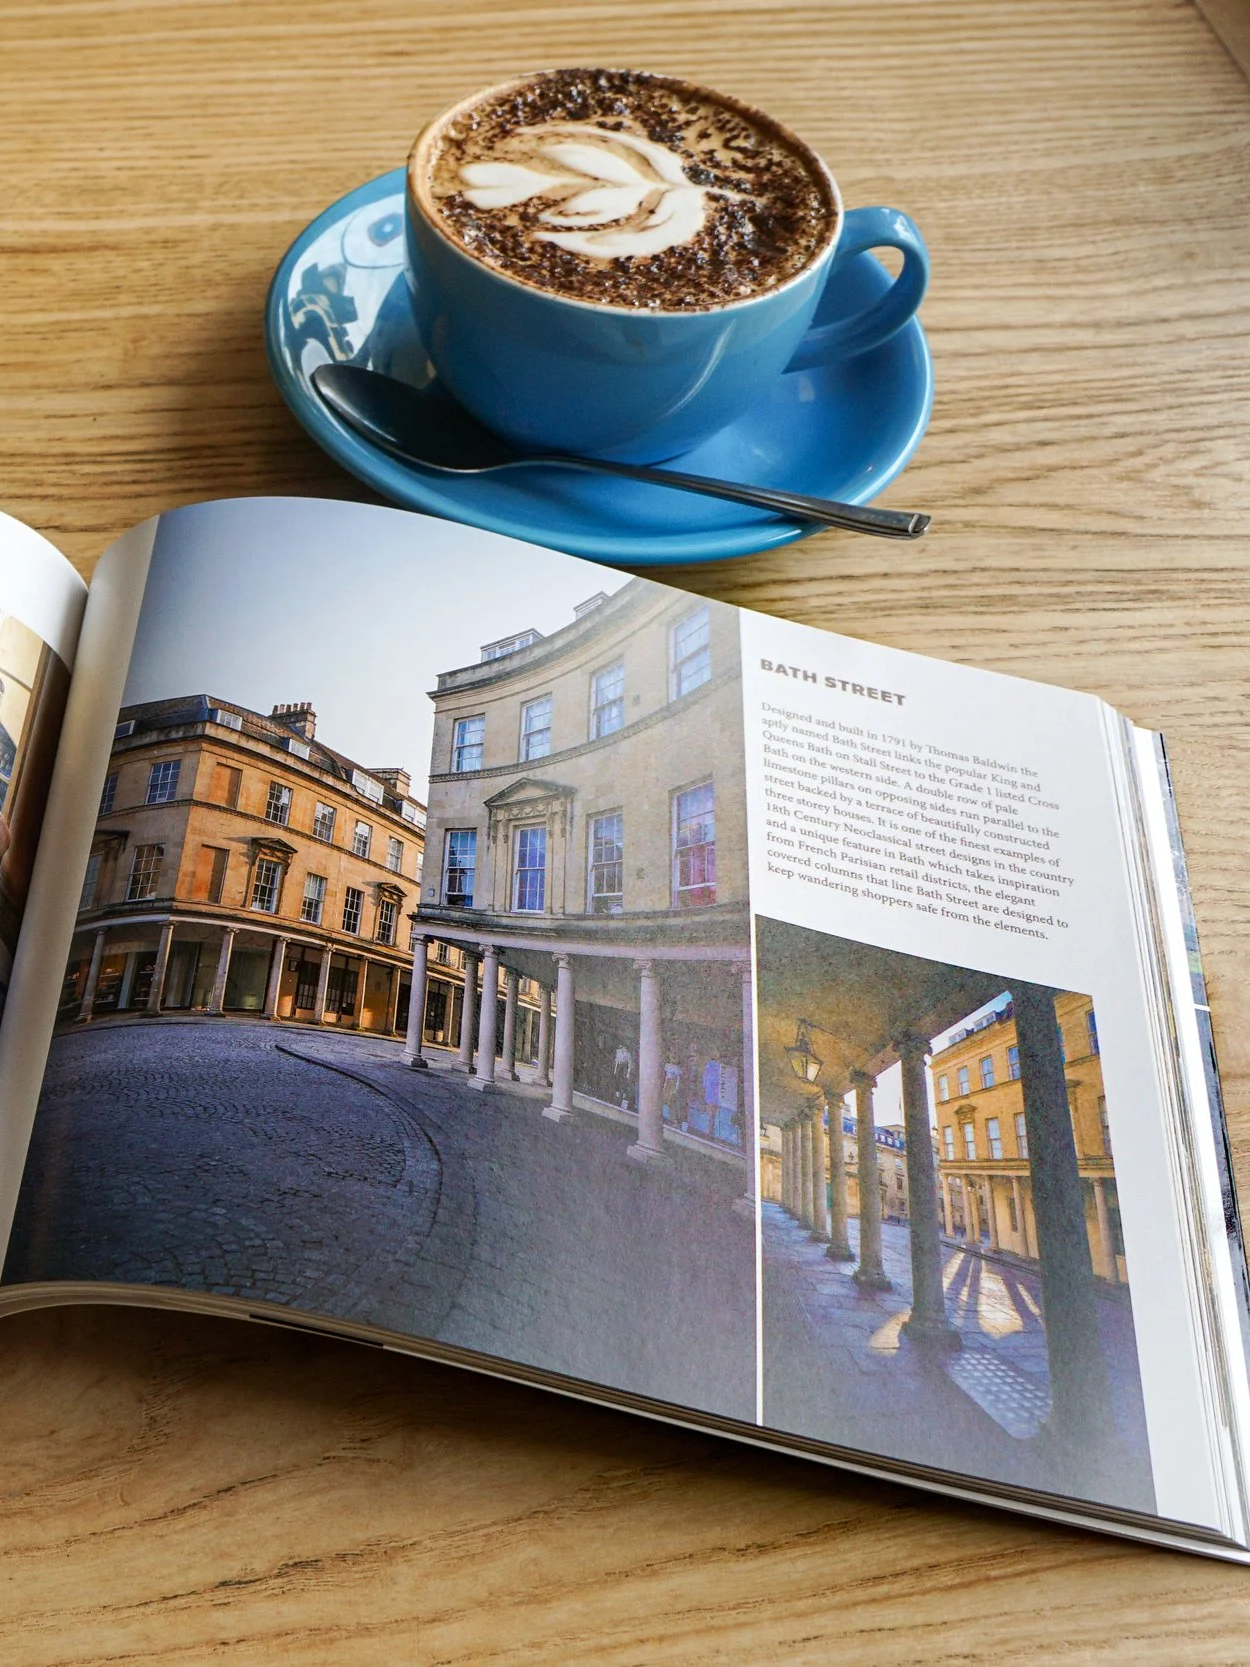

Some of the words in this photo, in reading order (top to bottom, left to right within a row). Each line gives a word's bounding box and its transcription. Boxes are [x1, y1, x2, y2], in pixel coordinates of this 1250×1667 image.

[760, 658, 817, 684] BATH
[825, 676, 906, 706] STREET
[766, 819, 787, 830] and
[800, 828, 839, 844] unique
[842, 837, 881, 854] feature
[884, 848, 895, 858] in
[899, 852, 924, 865] Bath
[928, 861, 962, 874] which
[966, 869, 994, 881] takes
[998, 875, 1059, 896] inspiration
[767, 803, 790, 816] 18th
[794, 810, 840, 831] Century
[843, 823, 911, 848] Neoclassical
[915, 843, 945, 856] street
[949, 850, 990, 866] designs
[994, 860, 1005, 869] in
[1008, 863, 1026, 874] the
[1030, 870, 1074, 886] country
[767, 832, 794, 847] from
[799, 841, 836, 858] French
[841, 852, 885, 871] Parisian
[890, 867, 918, 879] retail
[922, 873, 970, 892] districts,
[974, 885, 991, 896] the
[995, 891, 1035, 906] elegant
[767, 850, 811, 866] covered
[815, 863, 863, 880] columns
[866, 874, 887, 886] that
[892, 880, 912, 892] line
[917, 886, 942, 900] Bath
[946, 893, 978, 908] Street
[982, 904, 999, 913] are
[1003, 907, 1053, 925] designed
[768, 862, 794, 878] keep
[798, 873, 858, 897] wandering
[862, 888, 913, 908] shoppers
[916, 904, 937, 914] safe
[941, 907, 969, 921] from
[973, 916, 990, 926] the
[994, 921, 1048, 939] elements.
